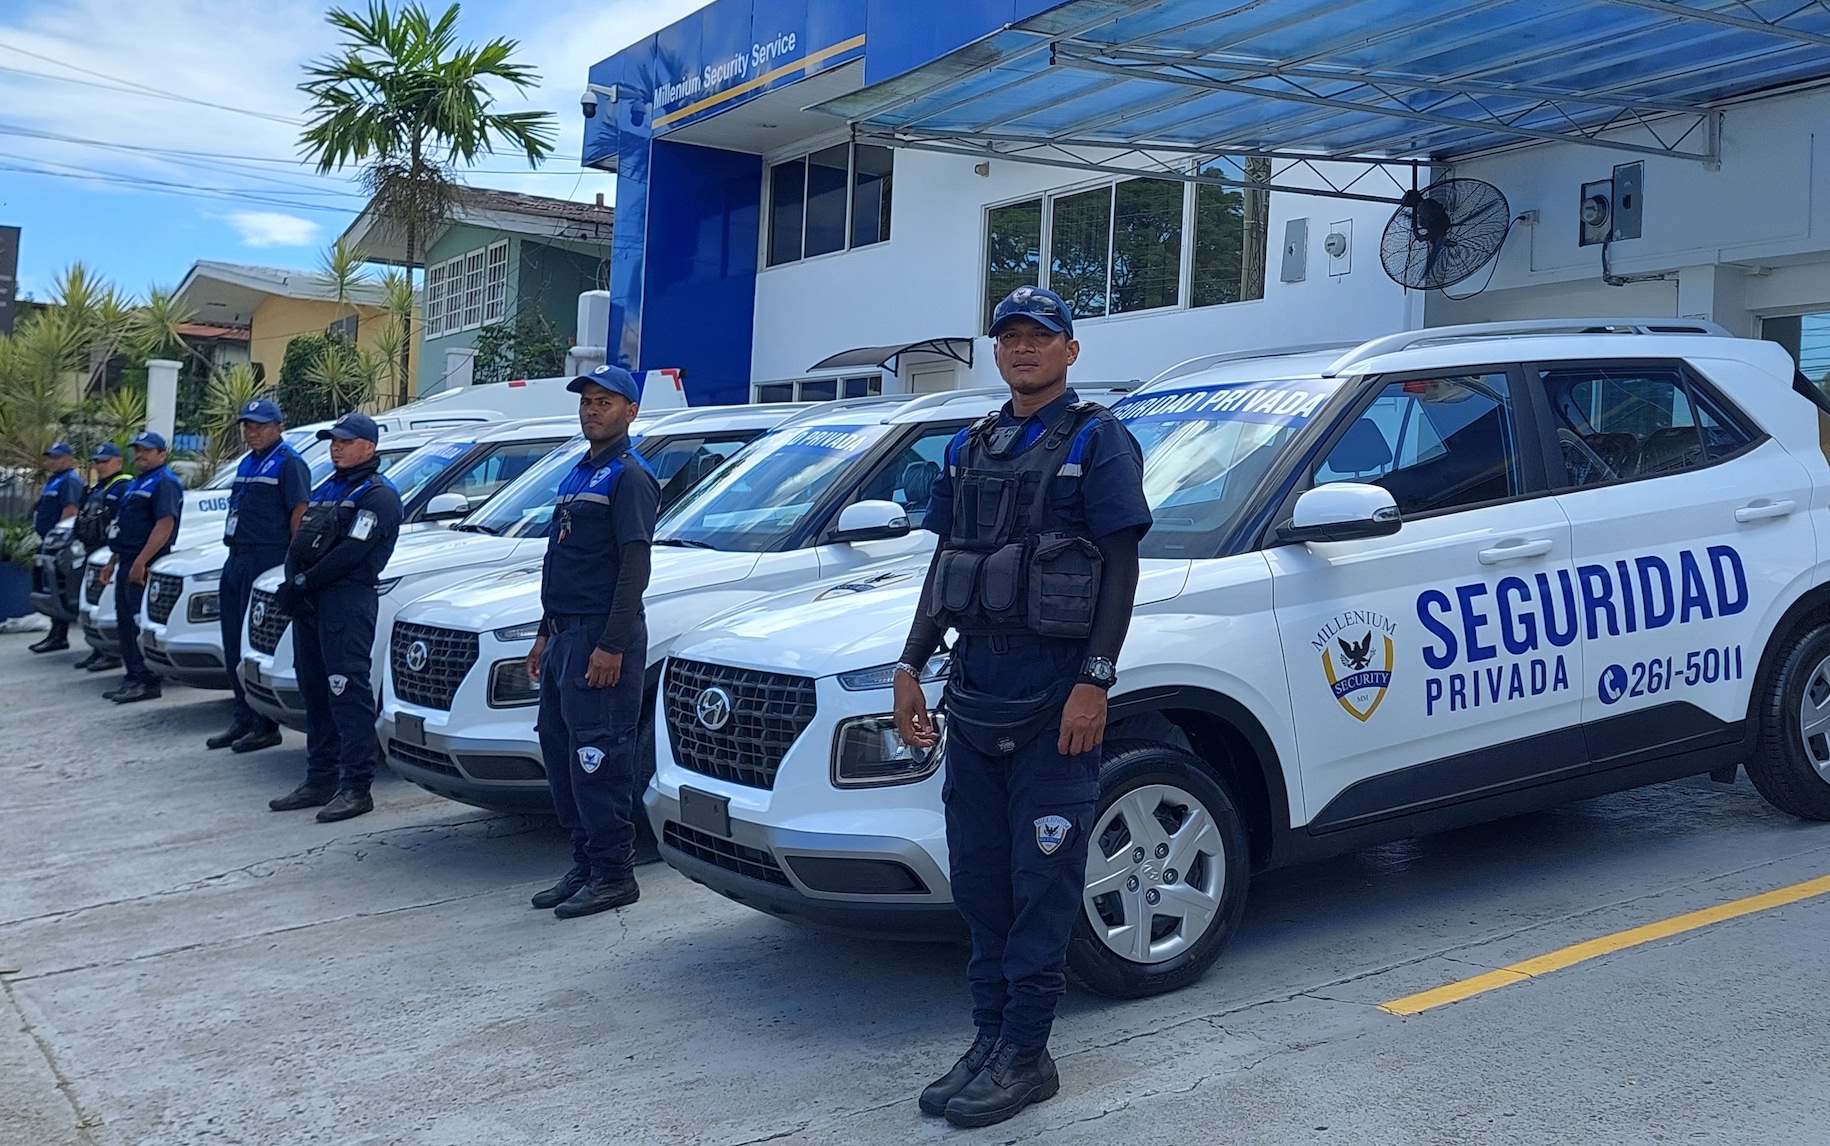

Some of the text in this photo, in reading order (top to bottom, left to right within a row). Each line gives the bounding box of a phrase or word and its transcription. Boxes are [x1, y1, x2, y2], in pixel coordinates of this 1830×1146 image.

[653, 32, 796, 109] Millenium Security Service
[1196, 390, 1326, 417] PRIVADA
[798, 431, 868, 452] PRIVADA
[198, 497, 231, 512] CU6
[1416, 545, 1749, 670] SEGURIDAD
[1311, 610, 1397, 652] MILLENIUM
[1334, 672, 1389, 695] SECURITY
[1426, 655, 1568, 716] PRIVADA
[1629, 645, 1743, 698] 261-5011
